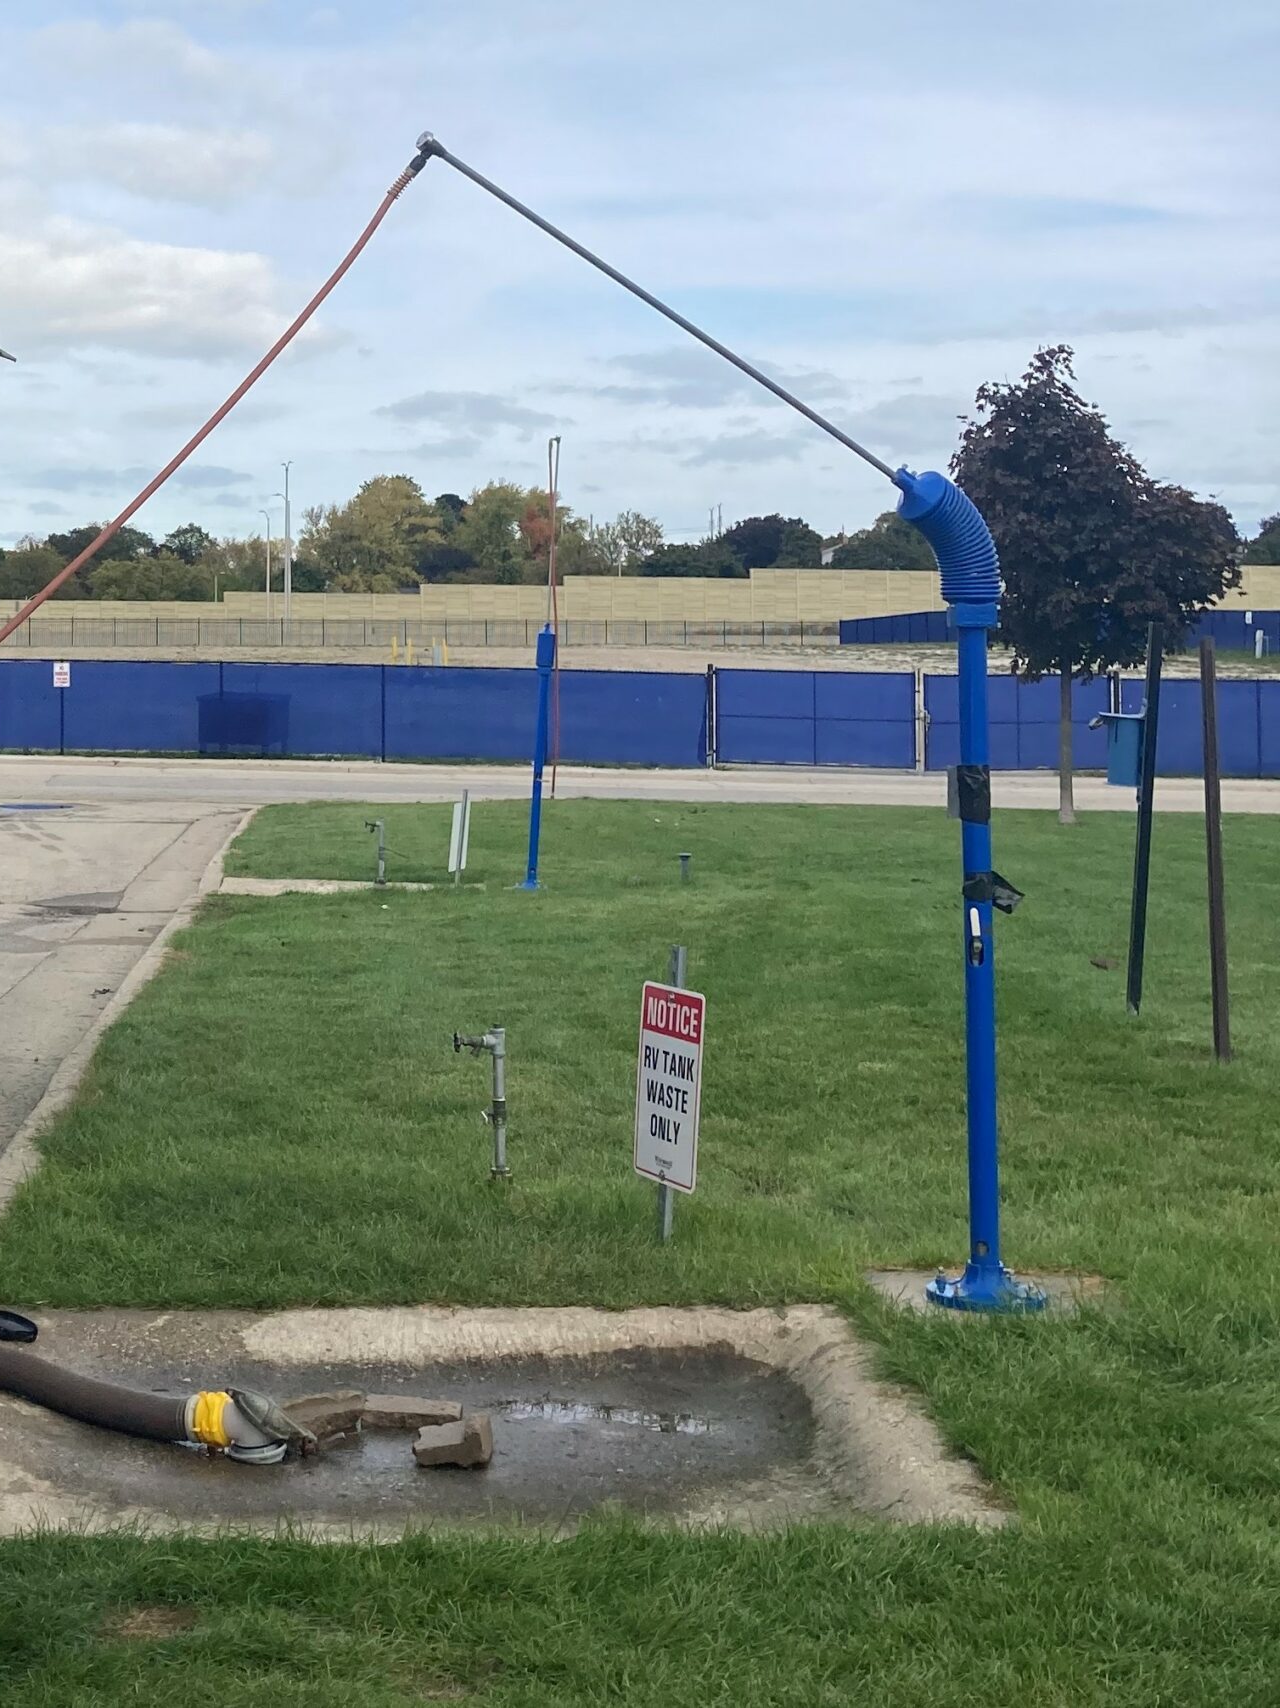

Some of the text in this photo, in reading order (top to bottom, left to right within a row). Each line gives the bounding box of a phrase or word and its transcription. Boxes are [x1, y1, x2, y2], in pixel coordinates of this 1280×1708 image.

[646, 996, 699, 1038] NOTICE
[644, 1045, 695, 1082] RV TANK
[646, 1078, 688, 1114] WASTE
[650, 1113, 680, 1145] ONLY
